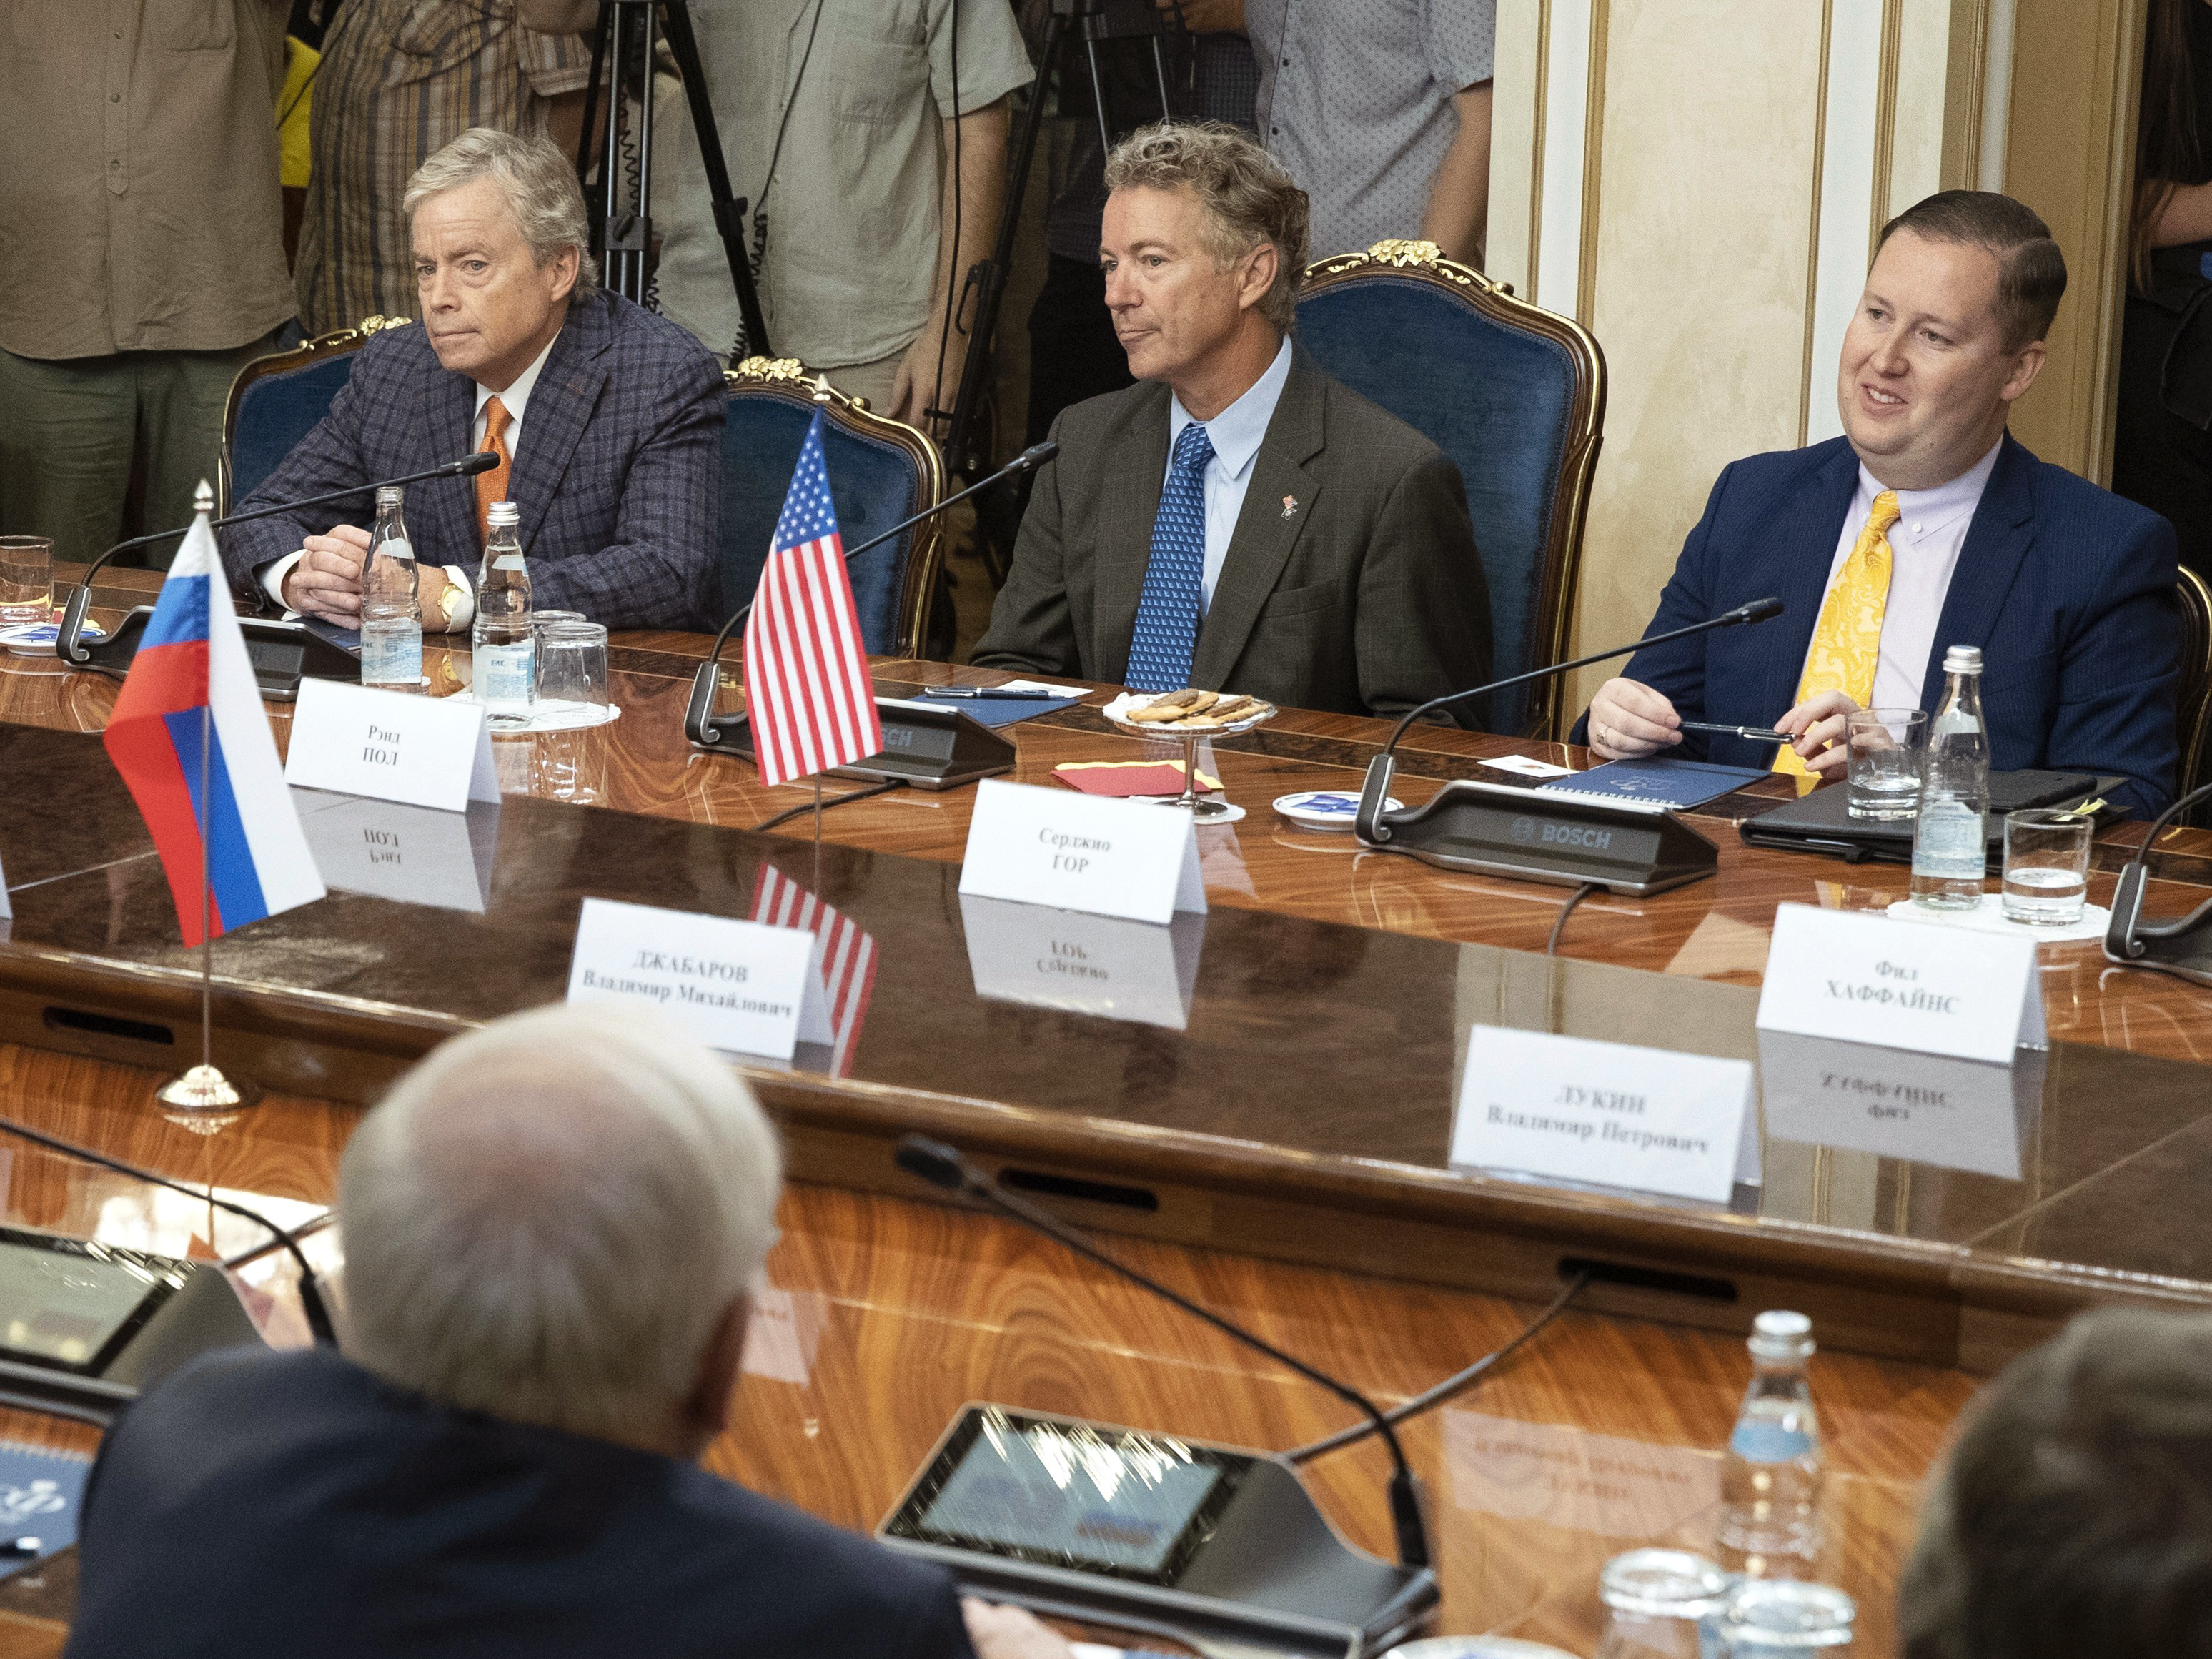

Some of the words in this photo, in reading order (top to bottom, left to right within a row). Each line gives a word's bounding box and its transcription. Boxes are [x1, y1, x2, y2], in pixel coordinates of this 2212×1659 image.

[368, 725, 400, 744] Рэнд
[363, 747, 398, 766] ПОЛ
[1039, 828, 1111, 852] Серджио
[1542, 823, 1611, 850] BOSCH
[1053, 854, 1089, 873] ГОР
[632, 949, 748, 984] ДЖАБАРОВ
[1875, 960, 1918, 981] Фил
[582, 969, 671, 1003] Владимир
[1825, 979, 1960, 1015] ХАФФАЙНС
[1554, 1085, 1646, 1114] ЛУКИН
[1487, 1104, 1594, 1143] Владимир
